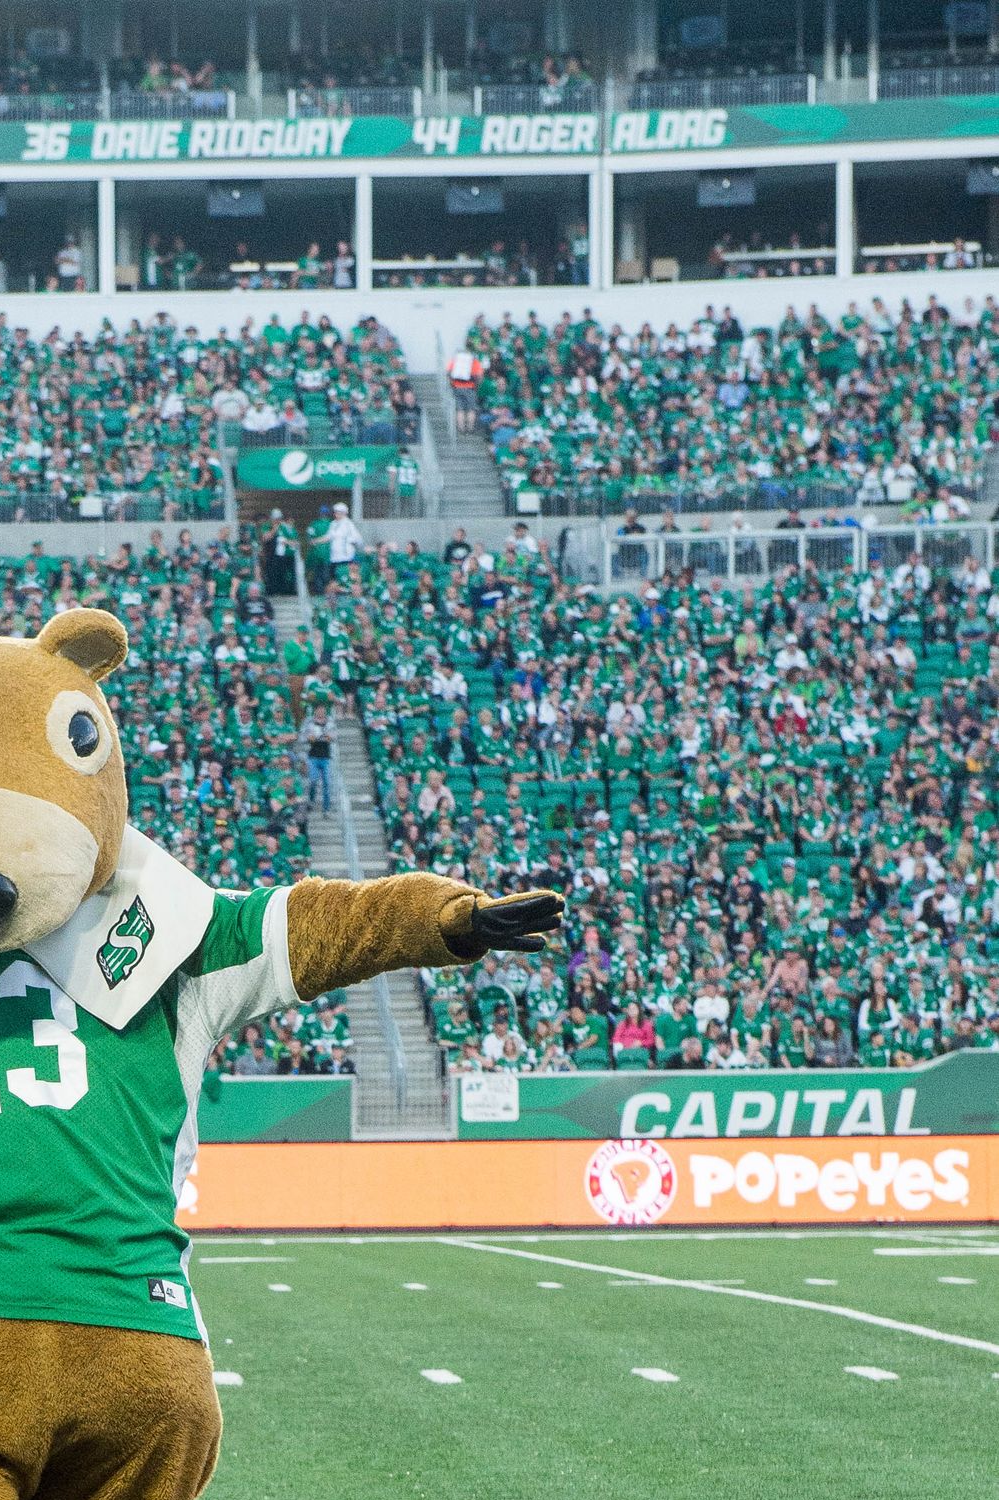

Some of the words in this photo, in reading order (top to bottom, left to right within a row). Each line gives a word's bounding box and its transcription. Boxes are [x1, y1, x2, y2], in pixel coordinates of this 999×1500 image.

[22, 123, 72, 160] 36
[90, 121, 184, 160] DAVE
[412, 117, 462, 155] 44
[480, 113, 598, 154] ROGER
[618, 1087, 933, 1139] CAPITAL
